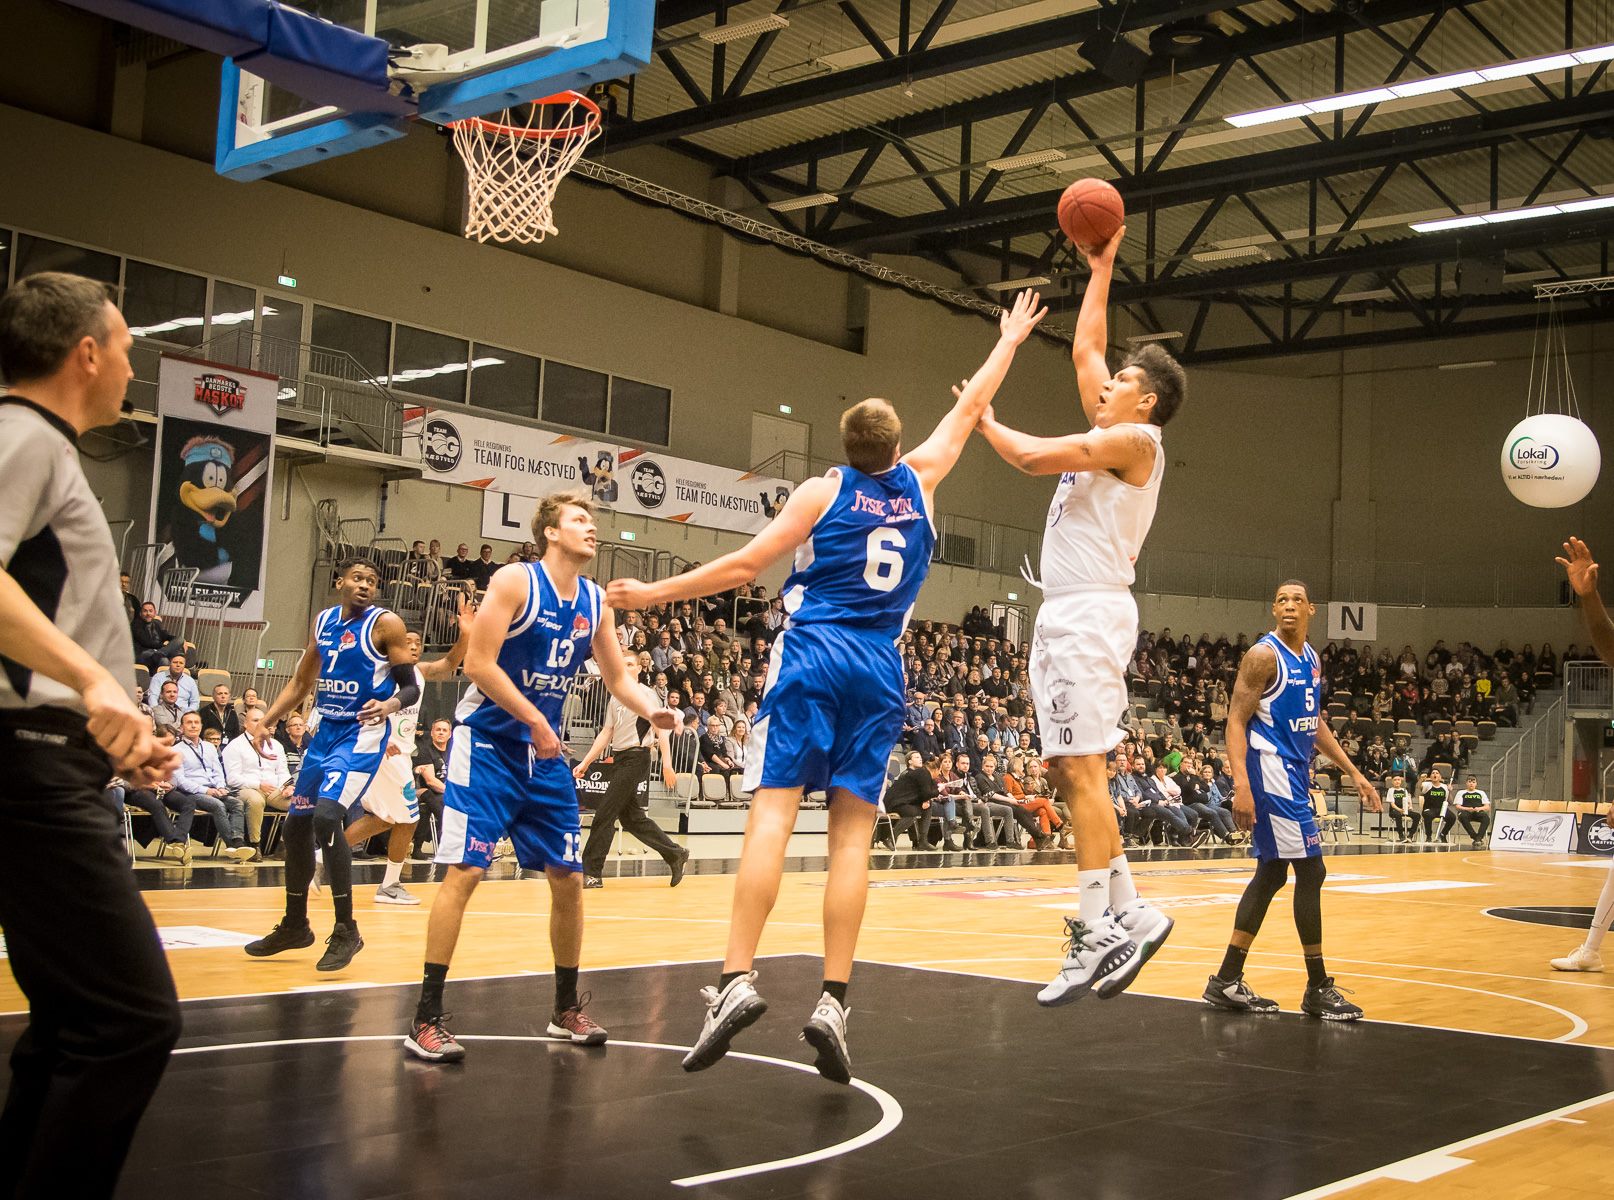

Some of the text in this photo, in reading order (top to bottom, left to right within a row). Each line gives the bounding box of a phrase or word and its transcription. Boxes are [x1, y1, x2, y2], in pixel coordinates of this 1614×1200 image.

[205, 377, 236, 388] DANMARKS
[194, 384, 245, 410] MASKOT
[433, 426, 448, 434] TEAM
[473, 440, 486, 448] HELE
[1517, 448, 1548, 459] Lokal
[474, 448, 576, 480] TEAM FOG NÆSTVED
[632, 471, 664, 495] FOG
[501, 493, 520, 528] L
[675, 486, 759, 514] TEAM FOG NÆSTVED
[863, 527, 906, 592] 6
[1341, 606, 1363, 631] N
[327, 650, 338, 673] 7
[547, 638, 575, 668] 13
[1305, 688, 1315, 712] 5
[1059, 727, 1073, 745] 10
[322, 771, 342, 791] 7
[563, 833, 583, 863] 13
